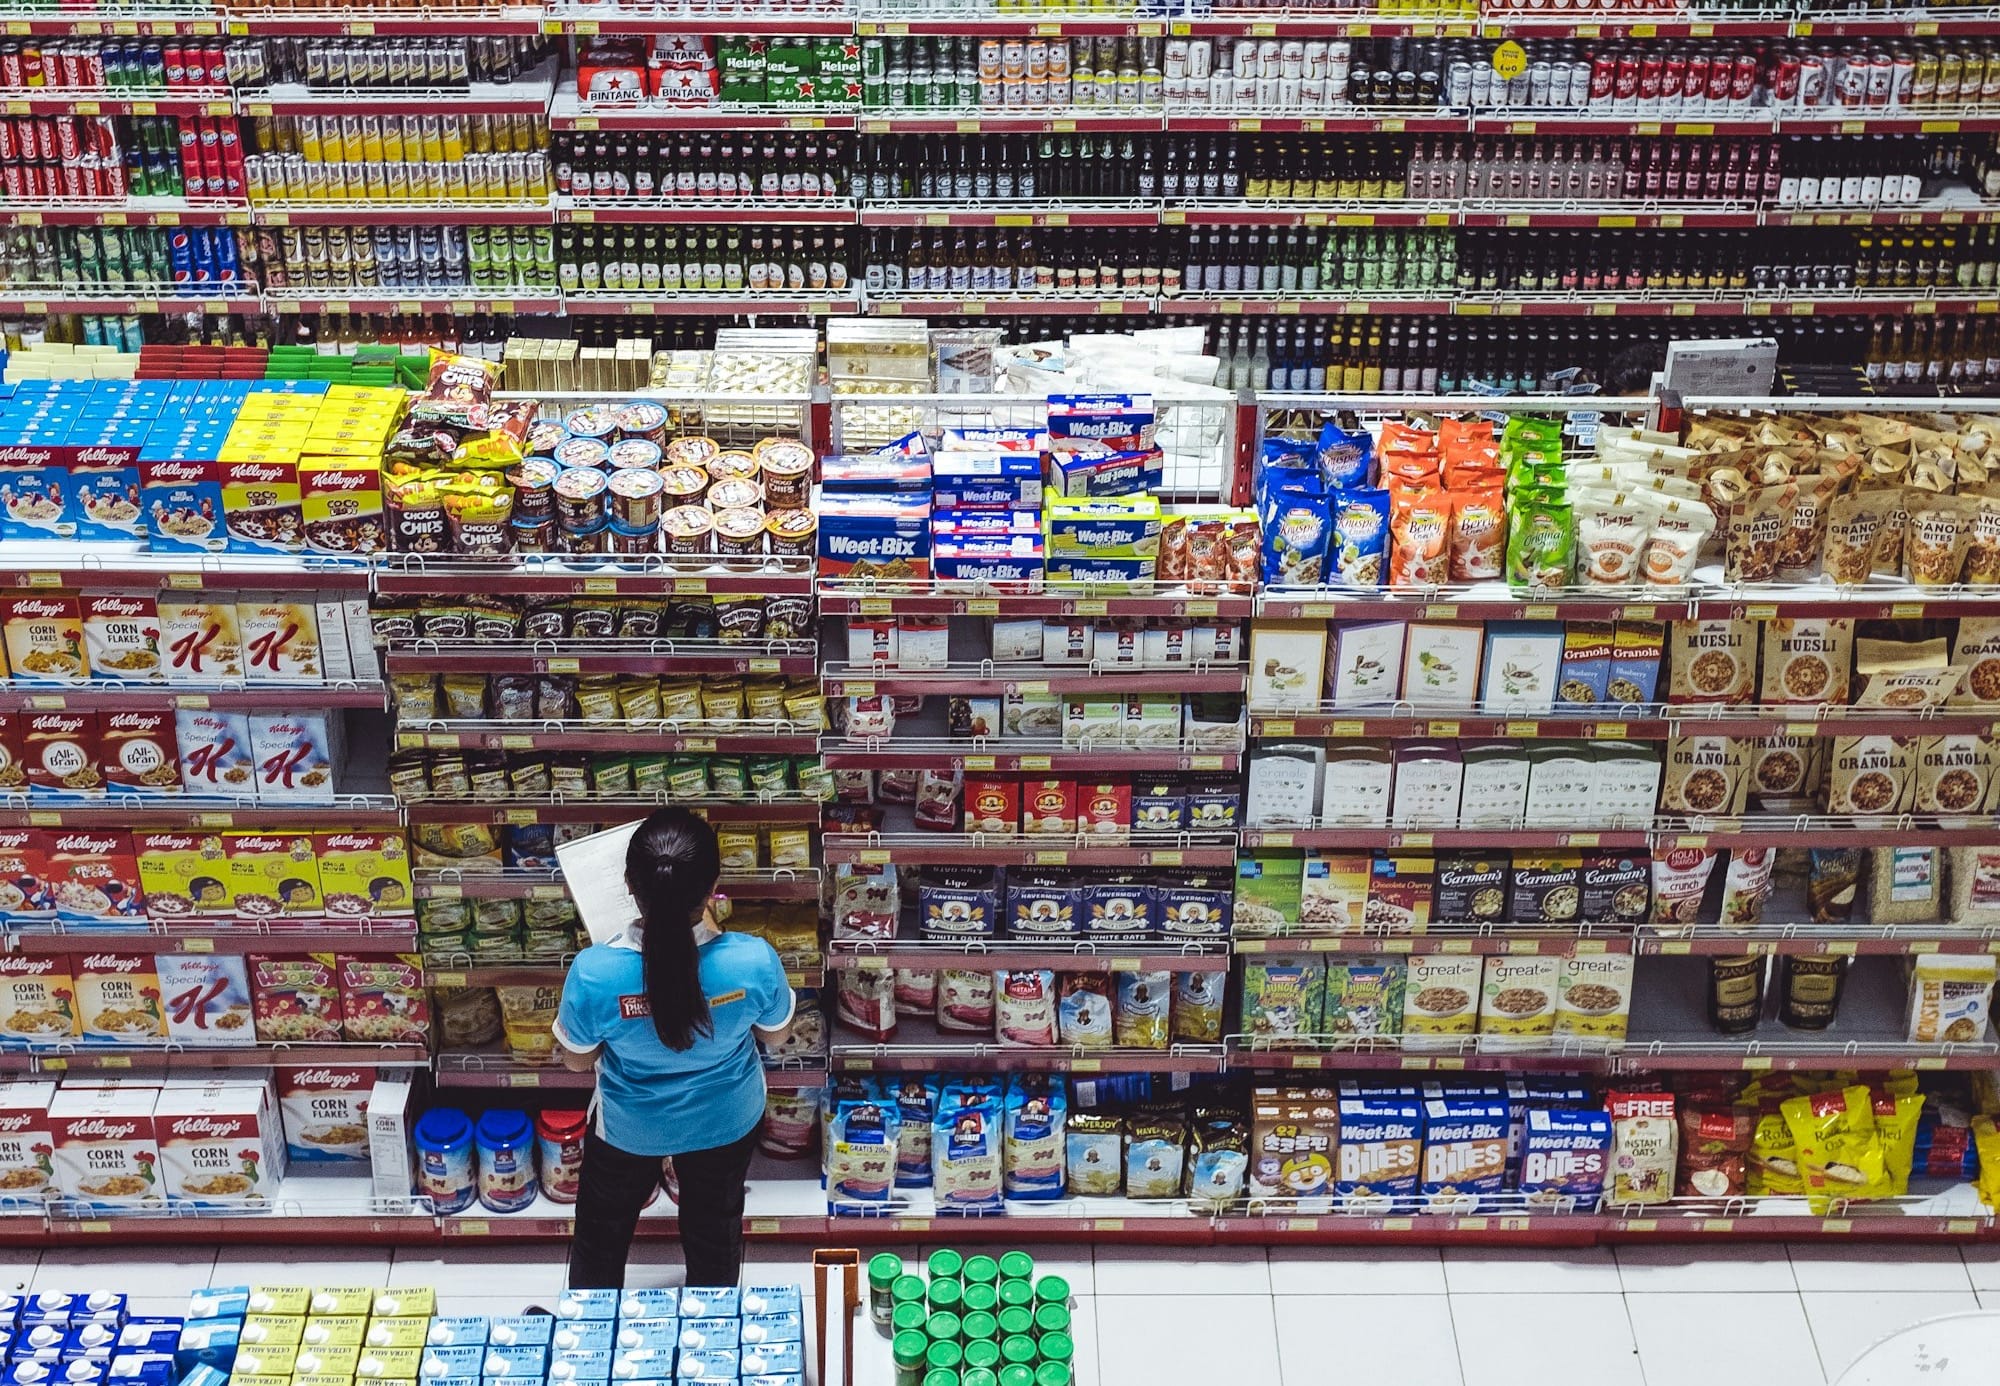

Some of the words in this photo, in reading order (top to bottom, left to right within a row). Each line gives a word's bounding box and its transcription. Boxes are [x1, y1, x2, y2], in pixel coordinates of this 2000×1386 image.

[656, 52, 704, 60] BINTANG
[591, 91, 639, 100] BINTANG
[662, 88, 711, 97] BINTANG
[1069, 421, 1134, 436] Weet-Bix
[964, 430, 1028, 441] Weet-Bix
[77, 449, 131, 464] Kellogg's
[150, 463, 205, 477] Kellogg's
[230, 465, 284, 478] Kellogg's
[311, 472, 366, 489] Kellogg's
[963, 490, 1011, 502] Weet-Bix
[404, 511, 439, 521] CHOCO
[1337, 515, 1381, 529] Knusper
[401, 520, 443, 535] CHIPS
[462, 524, 497, 533] CHOCO
[962, 519, 1011, 528] Weet-Bix
[1409, 522, 1442, 535] Berry
[1461, 519, 1494, 532] Berry
[460, 532, 503, 546] CHIPS
[1078, 529, 1134, 543] Weet-Bix
[1523, 531, 1566, 546] Original
[1924, 533, 1952, 541] BITES
[829, 536, 914, 555] Weet-Bix
[957, 564, 1022, 578] Weet-Bix
[1074, 568, 1128, 580] Weet-Bix
[12, 600, 65, 614] Kellogg's
[92, 599, 144, 613] Kellogg's
[181, 608, 213, 618] Kellogg's
[259, 608, 291, 617] Kellogg's
[106, 623, 138, 634] CORN
[166, 620, 200, 630] Special
[245, 619, 278, 629] Special
[29, 626, 56, 635] CORN
[31, 634, 57, 643] FLAKES
[108, 634, 140, 643] FLAKES
[1688, 636, 1742, 647] MUESLI
[170, 623, 220, 673] K
[248, 623, 299, 672] K
[1781, 639, 1837, 652] MUESLI
[1564, 646, 1611, 660] Granola
[1613, 648, 1660, 659] Granola
[1567, 667, 1599, 679] Blueberry
[1885, 677, 1940, 687] MUESLI
[32, 716, 84, 731] Kellogg's
[110, 713, 161, 729] Kellogg's
[184, 732, 217, 742] Special
[259, 741, 292, 750] Special
[50, 757, 81, 766] Bran
[127, 755, 156, 765] Bran
[187, 737, 235, 782] K
[262, 742, 312, 788] K
[1674, 753, 1741, 766] GRANOLA
[1839, 756, 1906, 770] GRANOLA
[1924, 754, 1991, 766] GRANOLA
[600, 765, 628, 779] ENERGEN
[673, 772, 702, 783] ENERGEN
[56, 836, 117, 853] Kellogg's
[146, 835, 192, 848] Kellogg's
[235, 837, 282, 850] Kellogg's
[327, 835, 373, 848] Kellogg's
[1441, 870, 1502, 885] Carman's
[1515, 869, 1576, 884] Carman's
[1585, 868, 1646, 884] Carman's
[945, 880, 968, 888] Ligo
[1034, 878, 1056, 887] Ligo
[1670, 881, 1699, 890] crunch
[1170, 895, 1215, 903] HAVERMOUT
[0, 958, 52, 974] Kellogg's
[83, 956, 142, 971] Kellogg's
[180, 961, 219, 972] Kellogg's
[1567, 959, 1611, 975] great
[1417, 964, 1461, 982] great
[1496, 963, 1540, 981] great
[165, 974, 207, 985] Special
[12, 984, 44, 993] CORN
[100, 981, 132, 991] CORN
[14, 992, 46, 1000] FLAKES
[102, 990, 134, 1000] FLAKES
[170, 977, 229, 1029] K
[293, 1071, 361, 1088] Kellogg's
[311, 1099, 347, 1110] CORN
[1626, 1101, 1673, 1116] FREE
[312, 1109, 349, 1119] FLAKES
[852, 1115, 880, 1123] QUAKER
[1021, 1114, 1048, 1122] QUAKER
[67, 1120, 135, 1138] Kellogg's
[172, 1117, 241, 1134] Kellogg's
[1073, 1120, 1118, 1129] HAVERJOY
[1552, 1123, 1587, 1132] Weet-Bix
[955, 1134, 980, 1142] QUAKER
[1341, 1125, 1415, 1140] Weet-Bix
[1429, 1125, 1502, 1140] Weet-Bix
[1529, 1136, 1604, 1149] Weet-Bix
[1624, 1139, 1662, 1148] INSTANT
[87, 1149, 125, 1160] CORN
[191, 1148, 228, 1159] CORN
[850, 1145, 873, 1153] GRATIS
[1632, 1148, 1656, 1156] OATS
[89, 1160, 126, 1170] FLAKES
[193, 1158, 230, 1169] FLAKES
